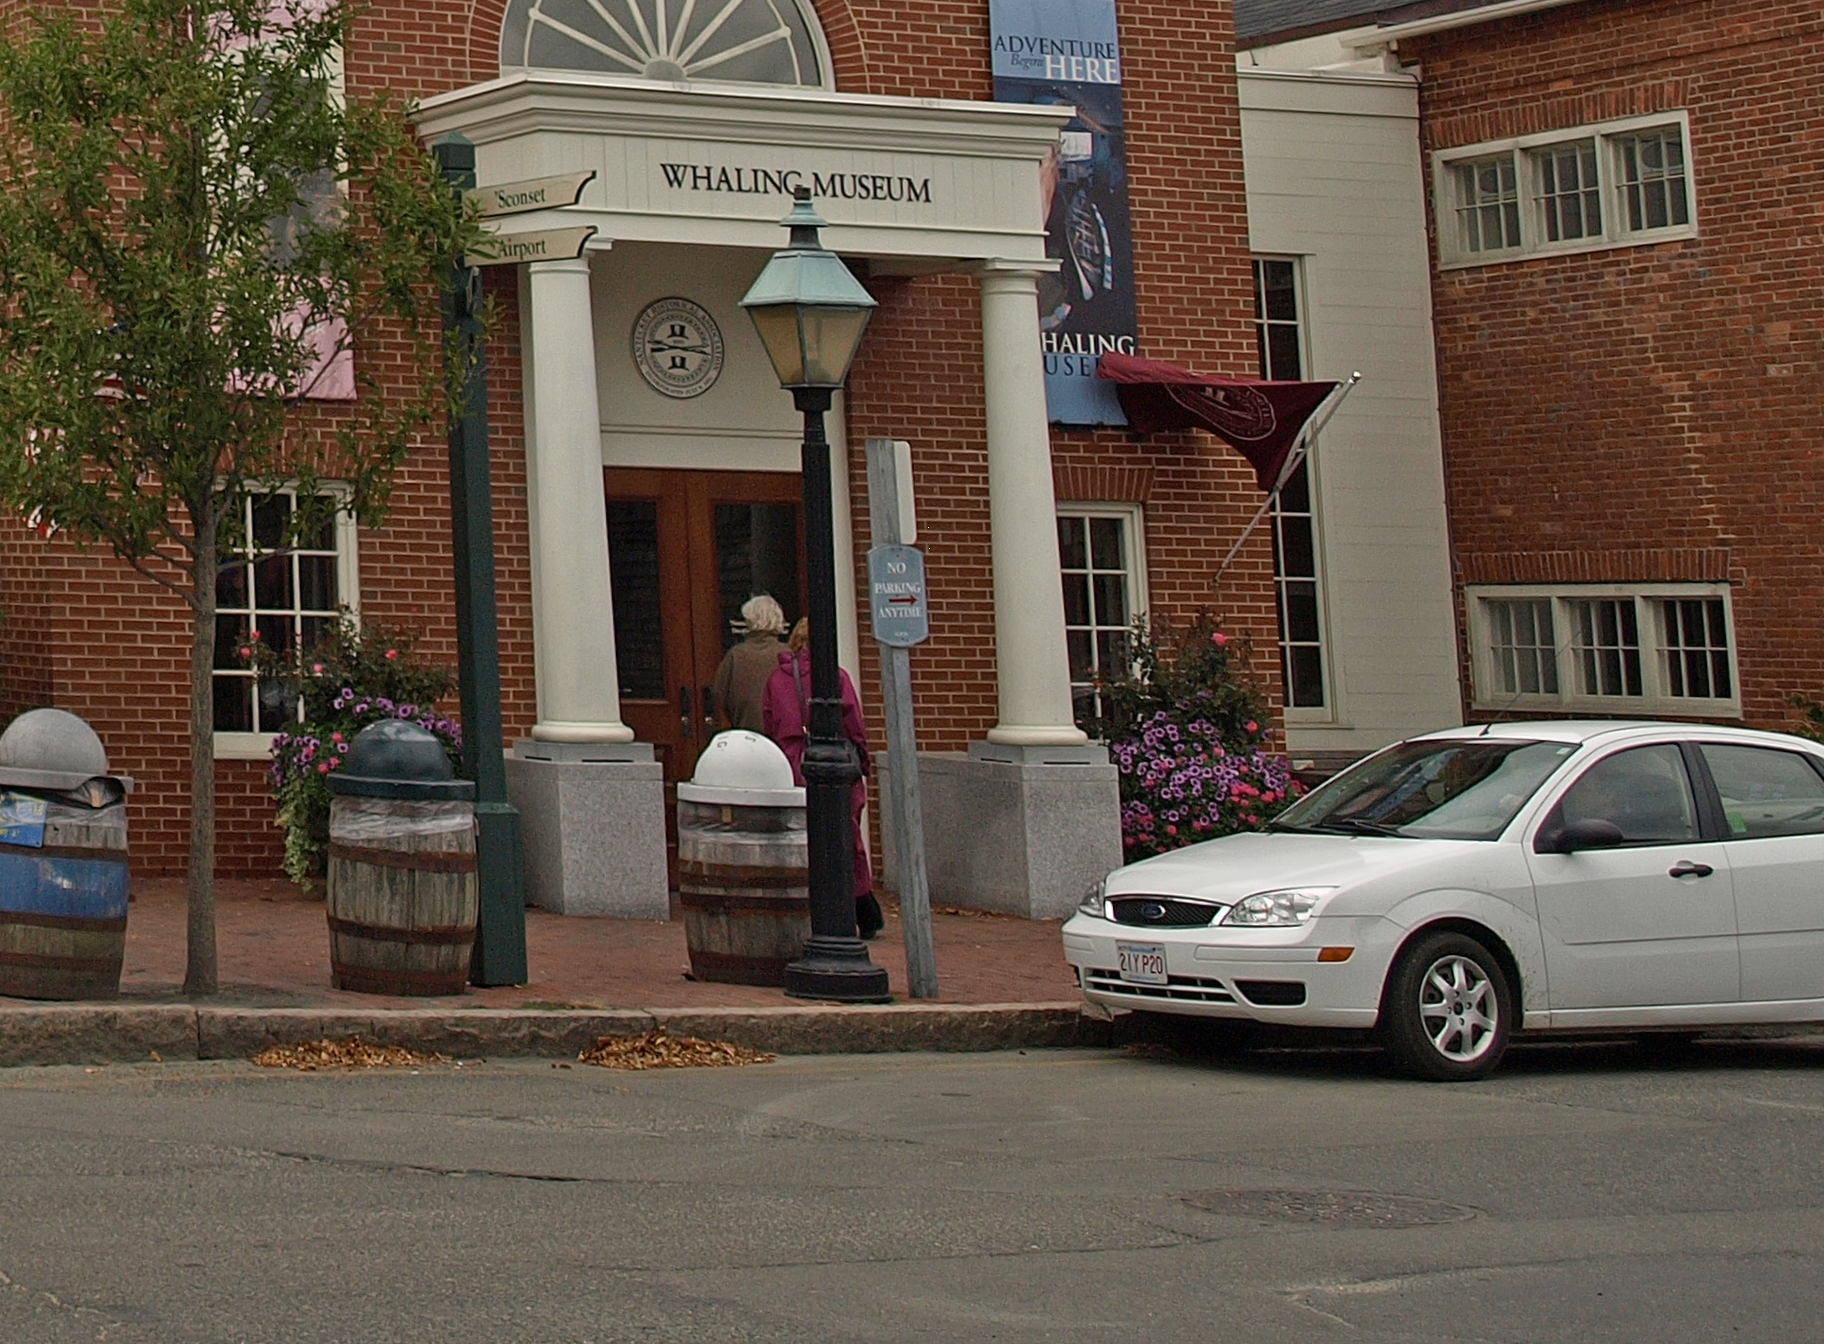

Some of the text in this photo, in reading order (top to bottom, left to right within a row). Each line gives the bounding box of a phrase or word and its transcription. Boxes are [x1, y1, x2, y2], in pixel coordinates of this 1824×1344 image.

[994, 35, 1116, 59] ADVENTURE
[1045, 54, 1118, 83] HERE
[660, 163, 932, 203] WHALING MUSEUM
[494, 187, 546, 209] 'Sconset
[498, 238, 546, 261] Airport
[1041, 332, 1135, 357] HALING
[887, 562, 907, 574] NO
[875, 582, 921, 594] PARKING
[879, 607, 922, 618] ANYTIME
